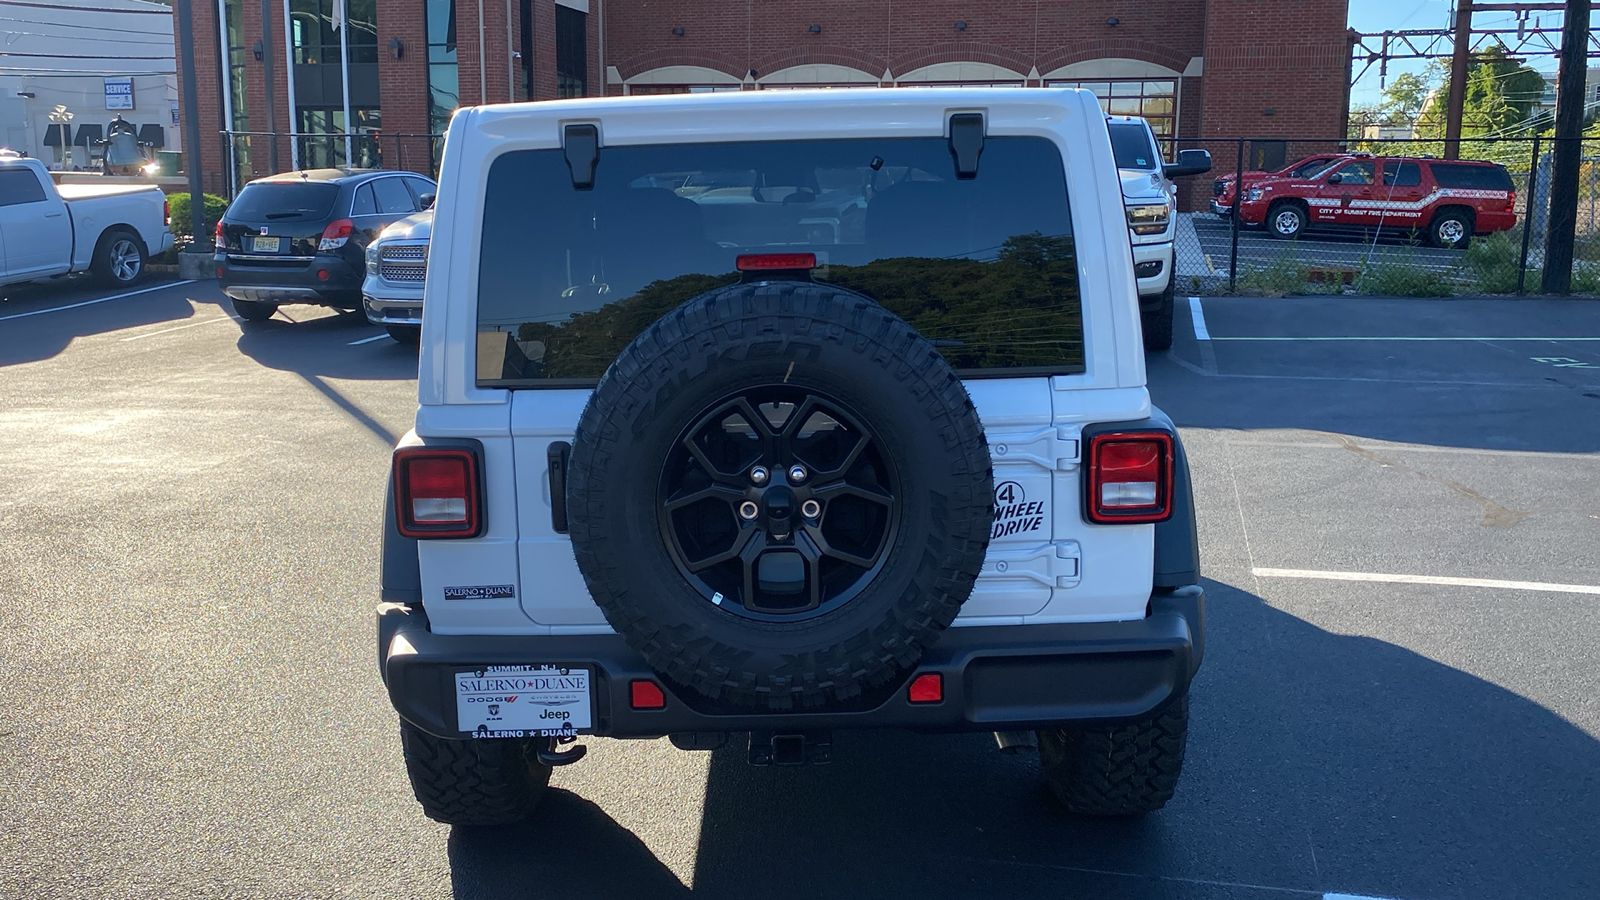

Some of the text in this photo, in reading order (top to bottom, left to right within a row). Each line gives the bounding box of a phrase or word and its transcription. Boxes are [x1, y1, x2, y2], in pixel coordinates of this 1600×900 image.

[105, 84, 131, 94] SERVICE
[1383, 210, 1422, 218] DEPARTMENT
[999, 485, 1015, 504] 4
[993, 501, 1044, 522] WHEEL
[993, 516, 1043, 539] DRIVE
[445, 586, 512, 596] SALERNO DUANE
[460, 677, 586, 692] SALERNO DUANE
[539, 709, 570, 720] Jeep
[472, 729, 578, 739] SALERNO DUANE
